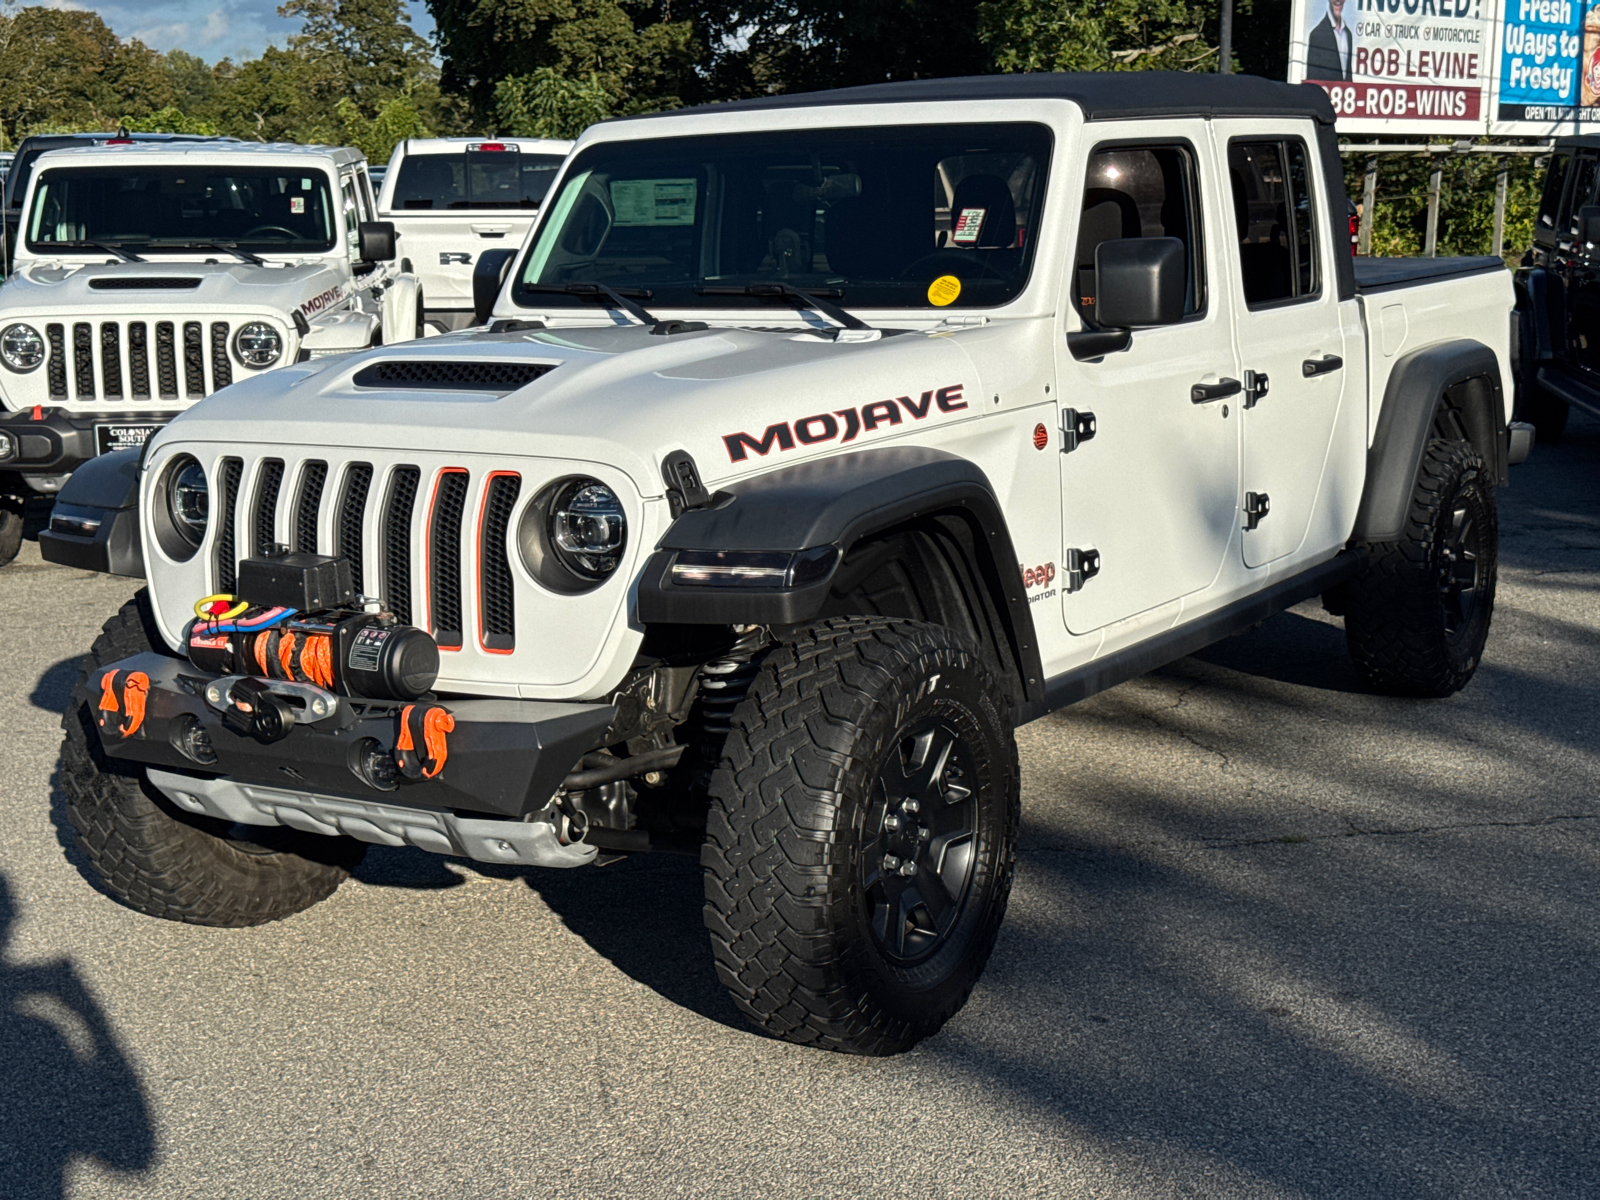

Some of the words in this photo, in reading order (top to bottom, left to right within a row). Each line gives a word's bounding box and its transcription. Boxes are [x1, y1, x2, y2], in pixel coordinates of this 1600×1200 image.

[1519, 0, 1571, 25] Fresh
[1365, 22, 1381, 37] CAR
[1395, 24, 1420, 39] TRUCK
[1433, 27, 1480, 43] MOTORCYCLE
[1505, 23, 1557, 65] Ways
[1560, 30, 1579, 58] to
[1356, 47, 1400, 76] ROB
[1405, 49, 1479, 79] LEVINE
[1510, 57, 1573, 98] Frosty
[1322, 86, 1467, 117] 88-ROB-WINS
[1525, 106, 1544, 120] OPEN
[300, 285, 341, 316] MOJAVE
[109, 428, 154, 437] COLONIA
[721, 383, 969, 463] MOJAVE
[1027, 588, 1057, 604] DIATOR
